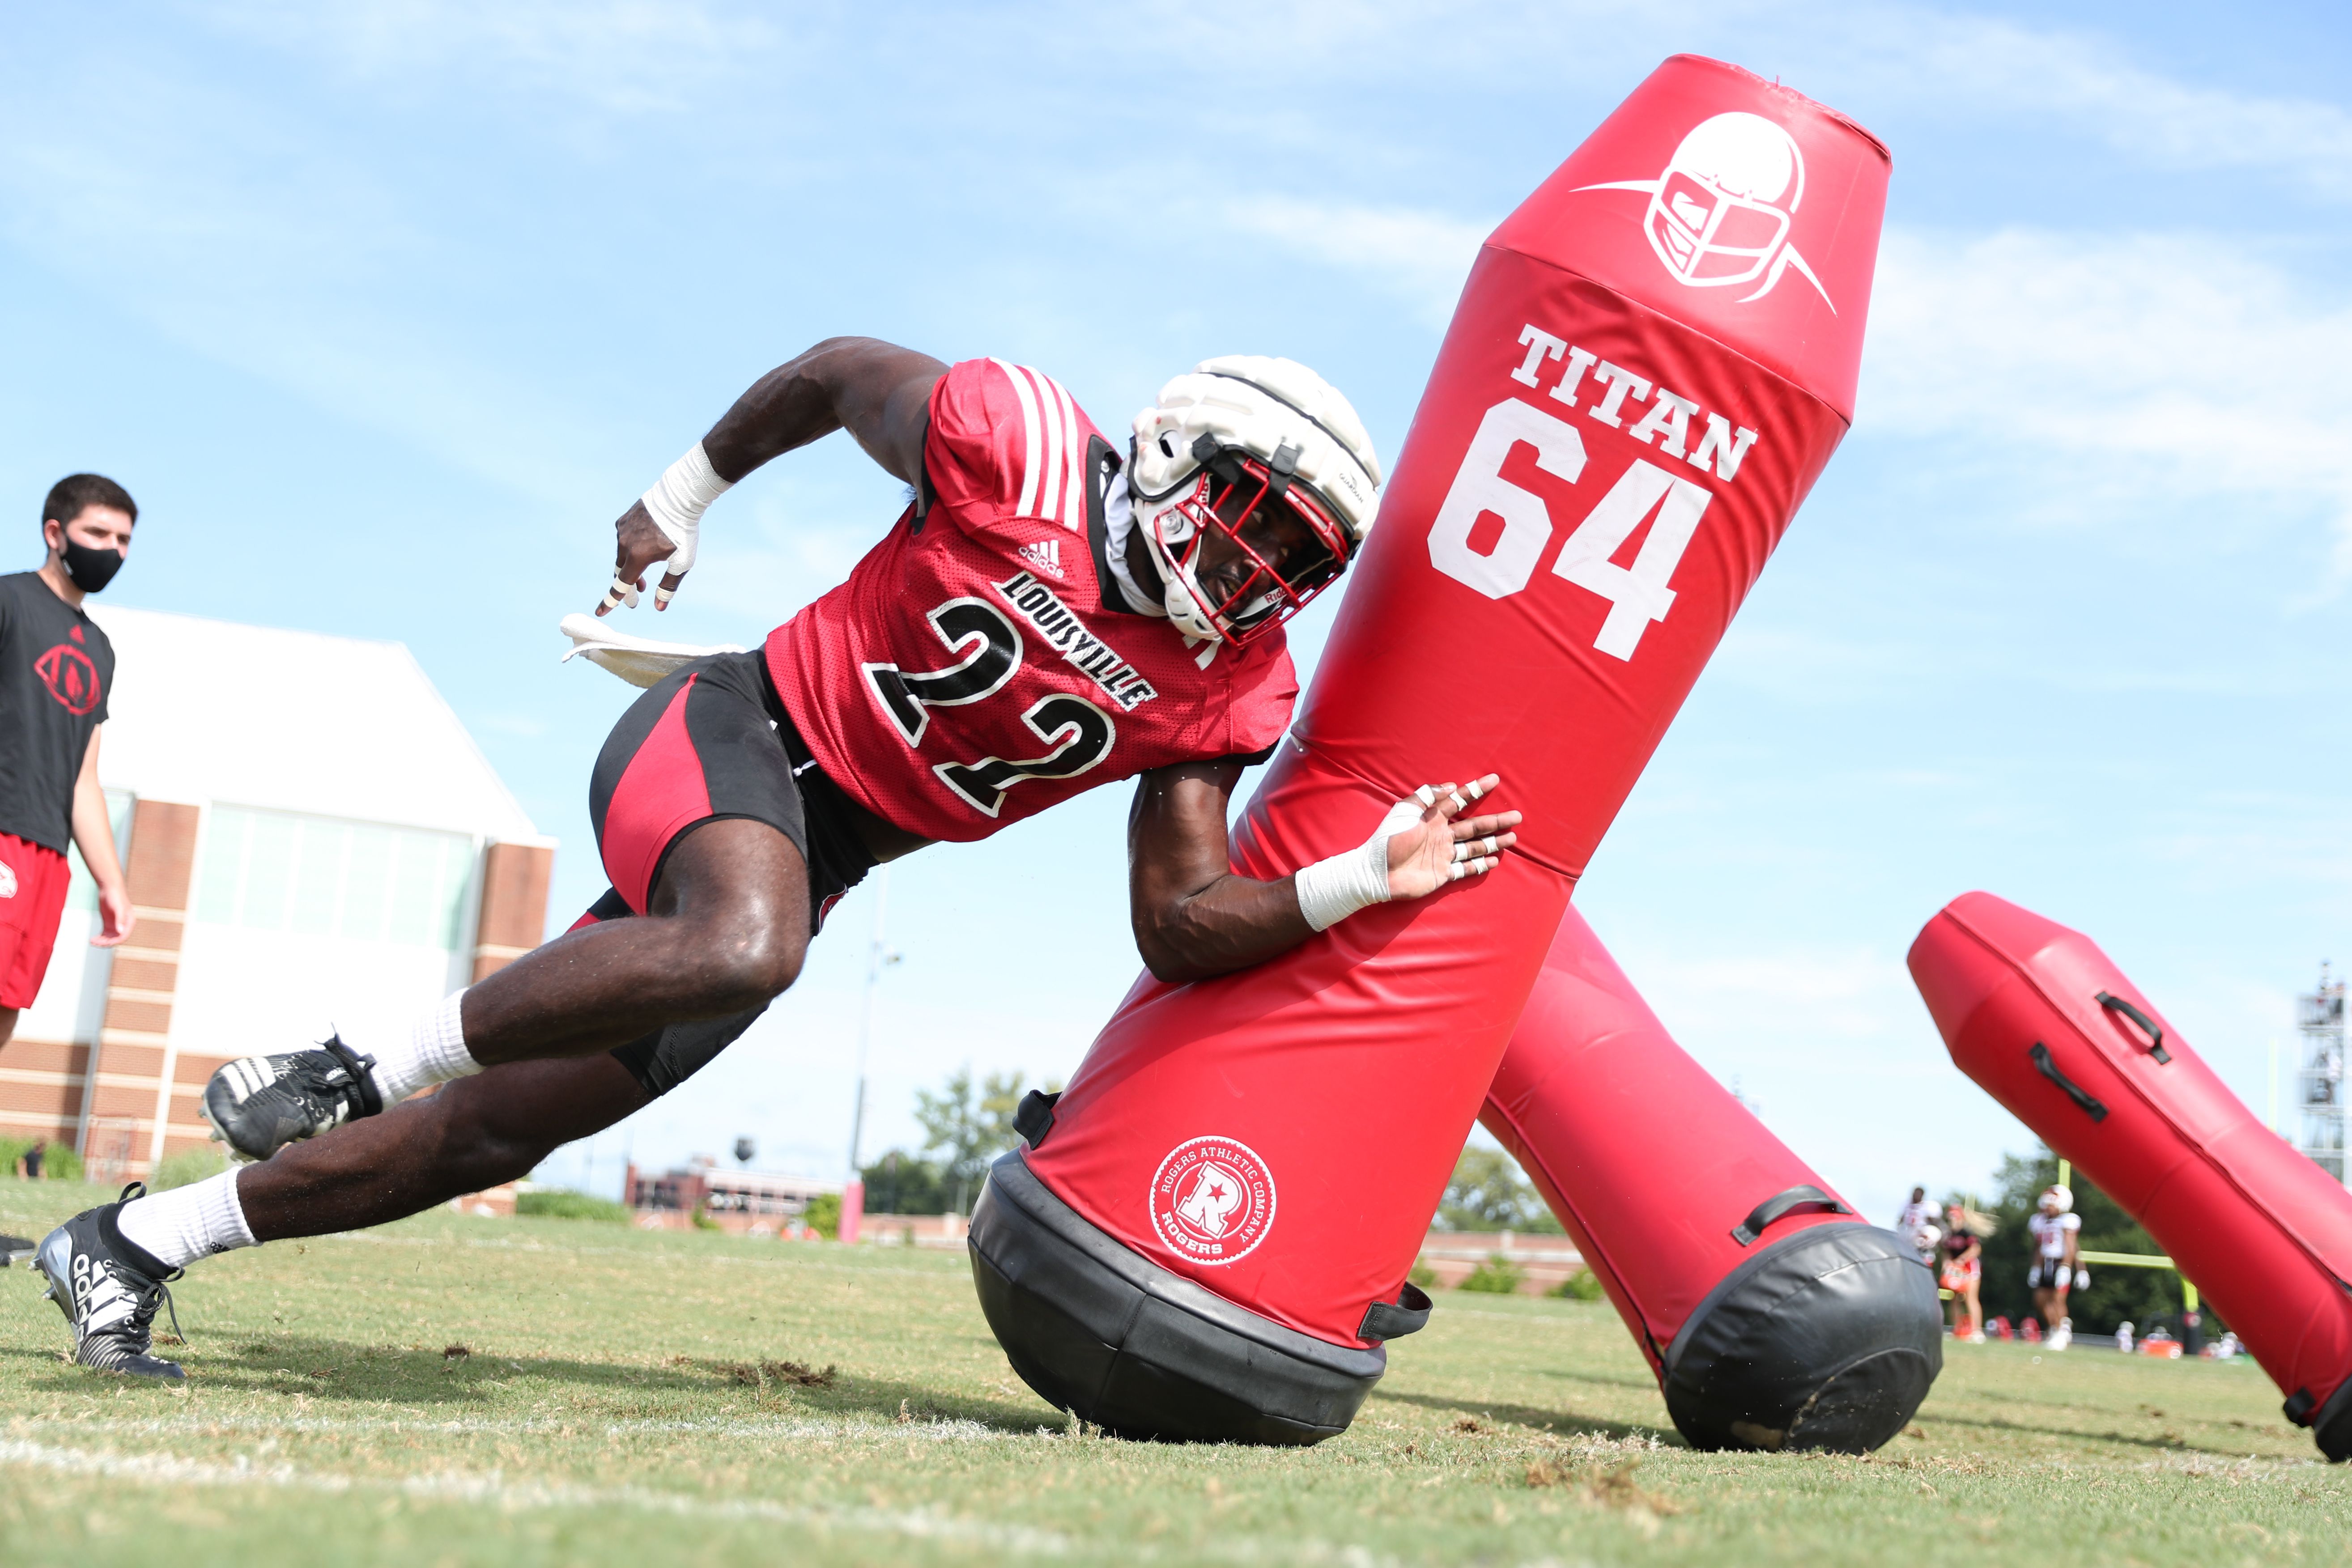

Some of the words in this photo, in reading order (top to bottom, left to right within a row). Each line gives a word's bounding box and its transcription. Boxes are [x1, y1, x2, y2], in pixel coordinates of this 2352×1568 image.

[1510, 323, 1758, 483] TITAN
[1339, 473, 1364, 504] GUARDIAN
[1427, 397, 1713, 663] 64
[1018, 547, 1064, 578] adidas
[1264, 587, 1288, 604] Ridd
[990, 569, 1158, 713] LOUISVILLE
[861, 596, 1116, 818] 22
[1161, 1151, 1197, 1194] ROGERS
[1200, 1147, 1258, 1180] ATHLETIC
[1239, 1181, 1266, 1243] COMPANY
[1161, 1211, 1223, 1254] ROGERS
[1175, 1160, 1243, 1240] R
